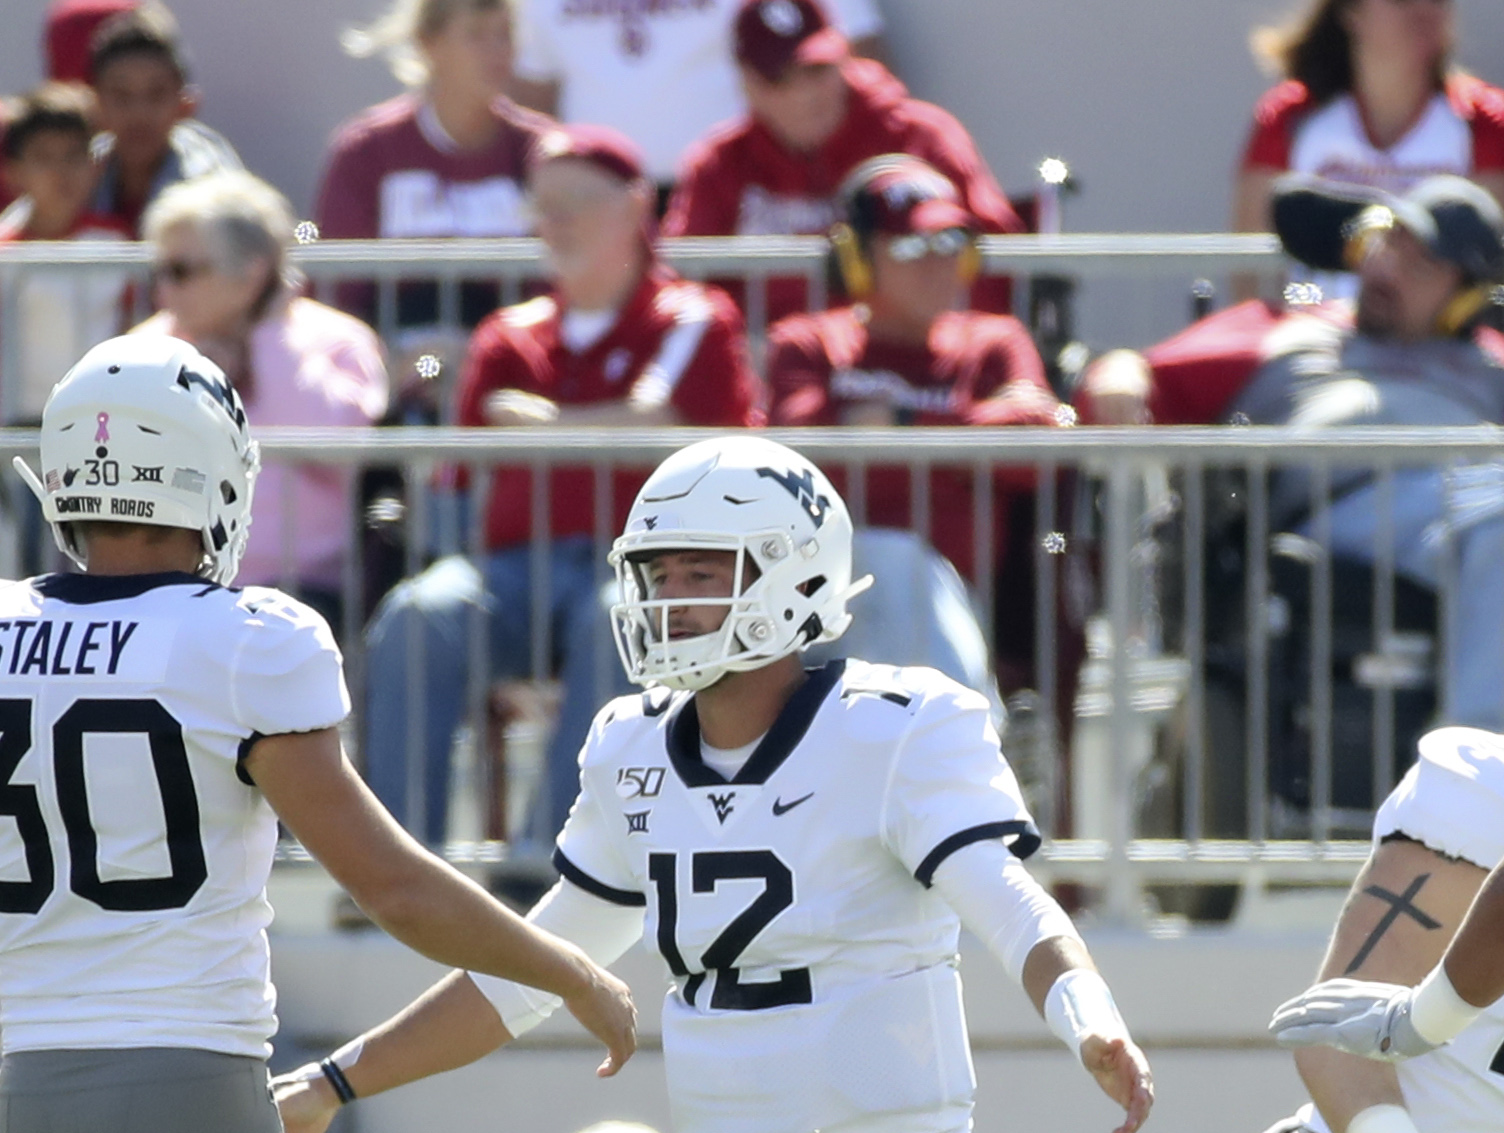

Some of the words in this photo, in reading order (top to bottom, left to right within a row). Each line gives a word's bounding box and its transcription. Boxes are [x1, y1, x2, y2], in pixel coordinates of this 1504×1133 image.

[84, 460, 119, 486] 30
[111, 497, 155, 517] ROADS
[616, 767, 668, 798] 150
[648, 850, 813, 1010] 12
